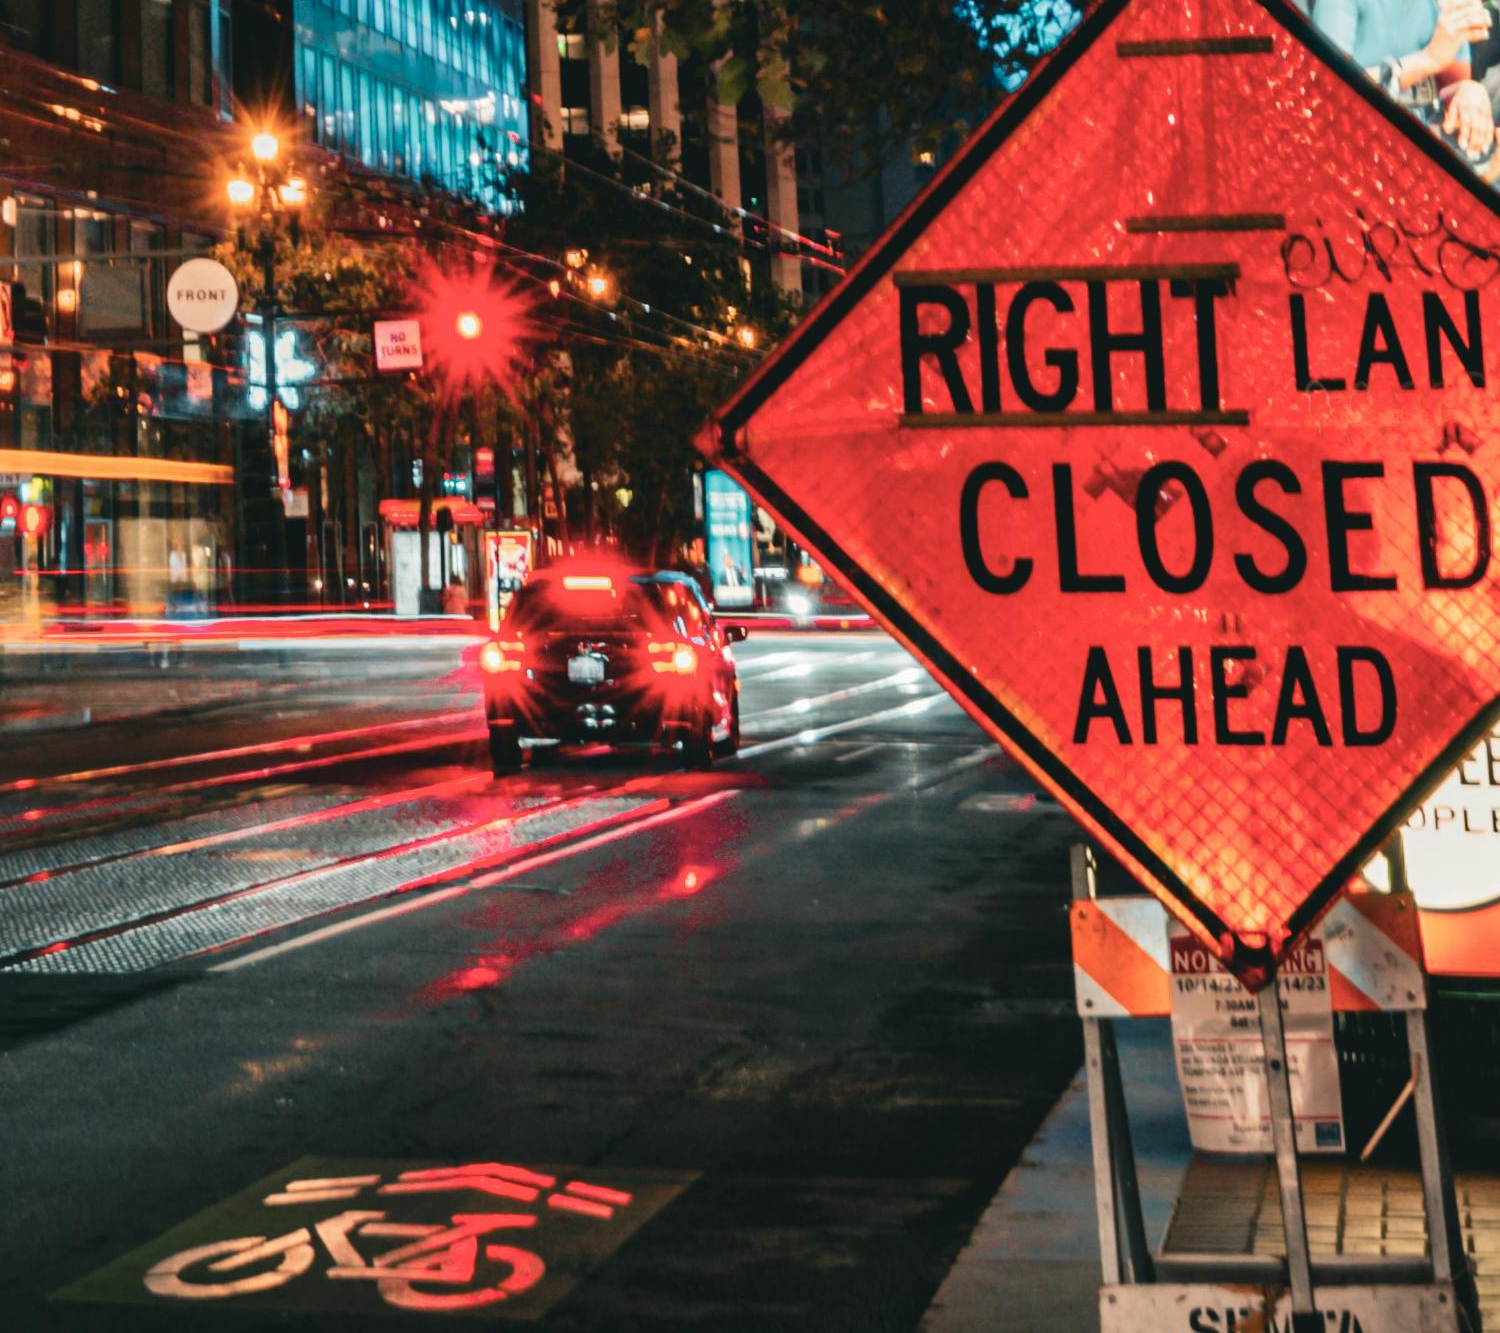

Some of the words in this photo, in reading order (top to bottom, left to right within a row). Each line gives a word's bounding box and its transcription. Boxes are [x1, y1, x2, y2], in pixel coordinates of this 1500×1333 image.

[176, 289, 227, 302] FRONT
[381, 343, 418, 358] TURNS
[898, 277, 1240, 415] RIGHT
[959, 459, 1491, 595] CLOSED
[1073, 644, 1398, 747] AHEAD
[1174, 951, 1206, 973] NO
